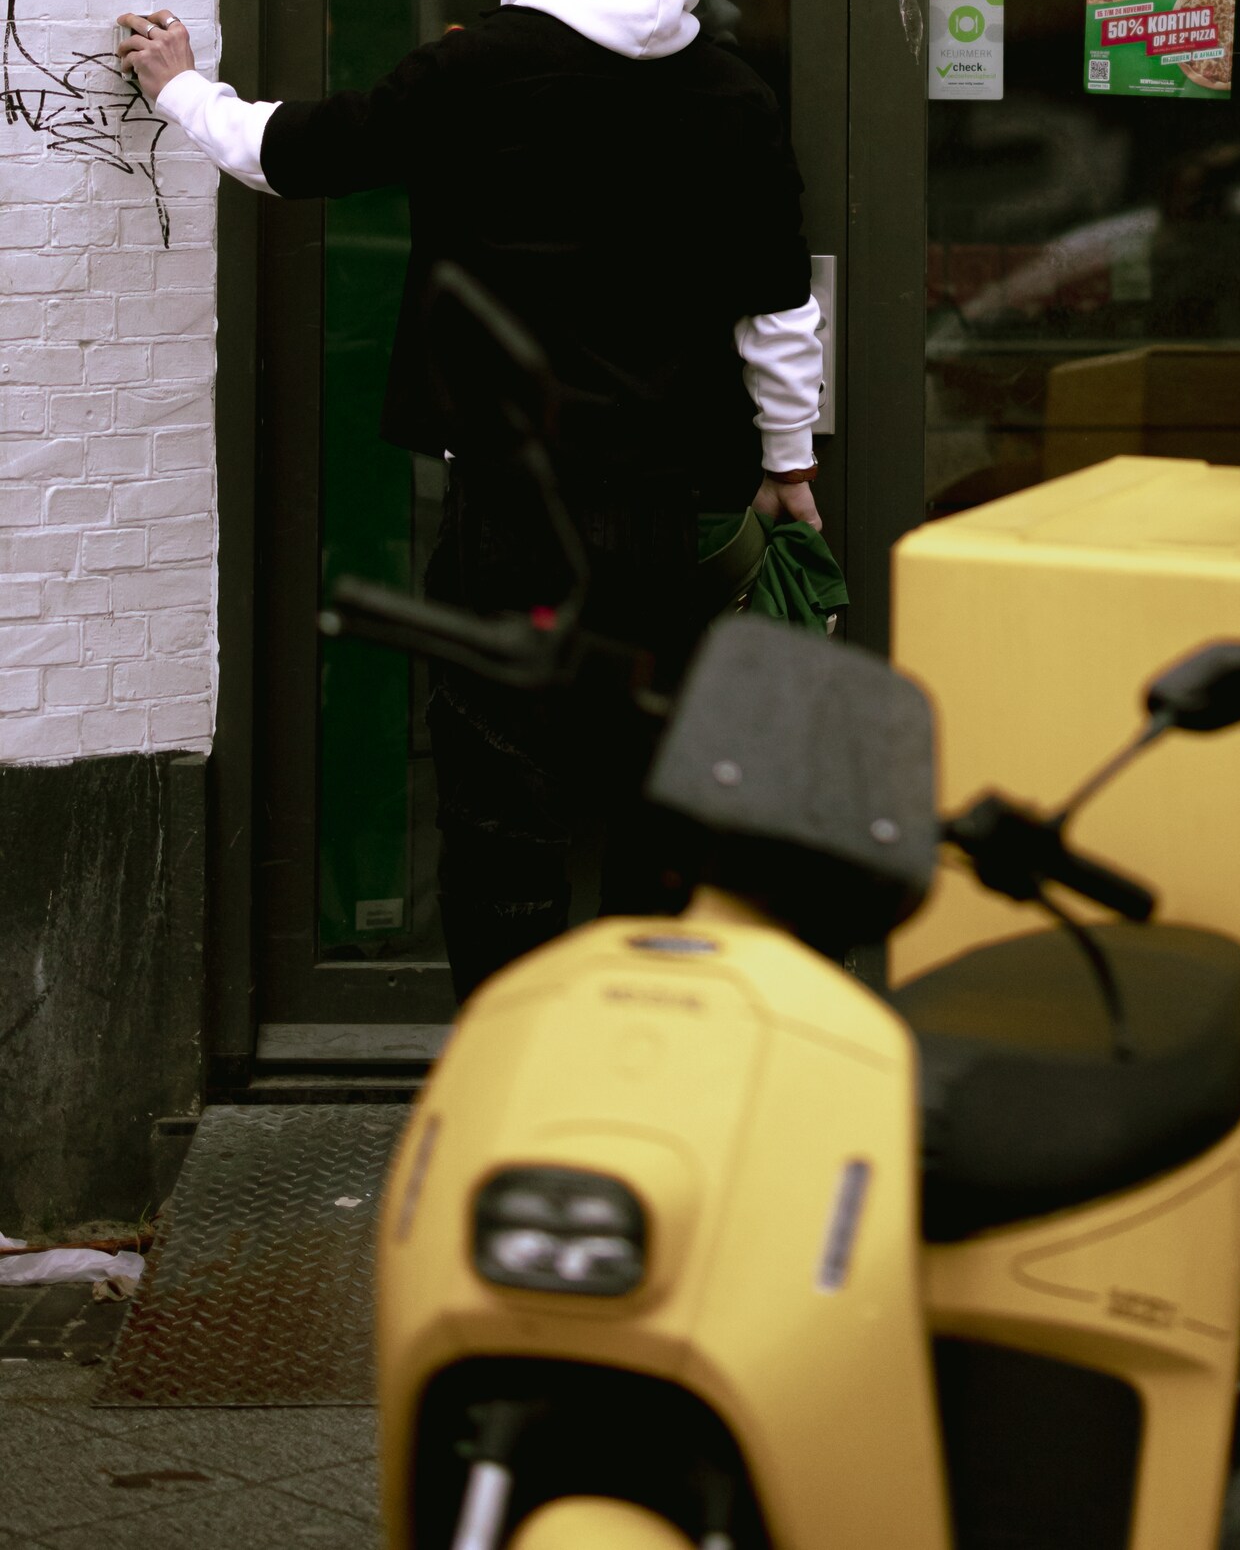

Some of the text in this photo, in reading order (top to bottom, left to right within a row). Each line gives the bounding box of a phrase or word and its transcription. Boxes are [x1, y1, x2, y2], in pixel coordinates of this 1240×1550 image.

[1123, 5, 1152, 14] NOVEMBER
[1108, 10, 1210, 39] 50% KORTING
[1153, 35, 1165, 47] OP
[1168, 34, 1177, 44] JE
[1190, 29, 1216, 41] PIZZA
[940, 50, 993, 58] KEURMERK
[1199, 50, 1222, 59] AFHALEN
[953, 63, 982, 72] check
